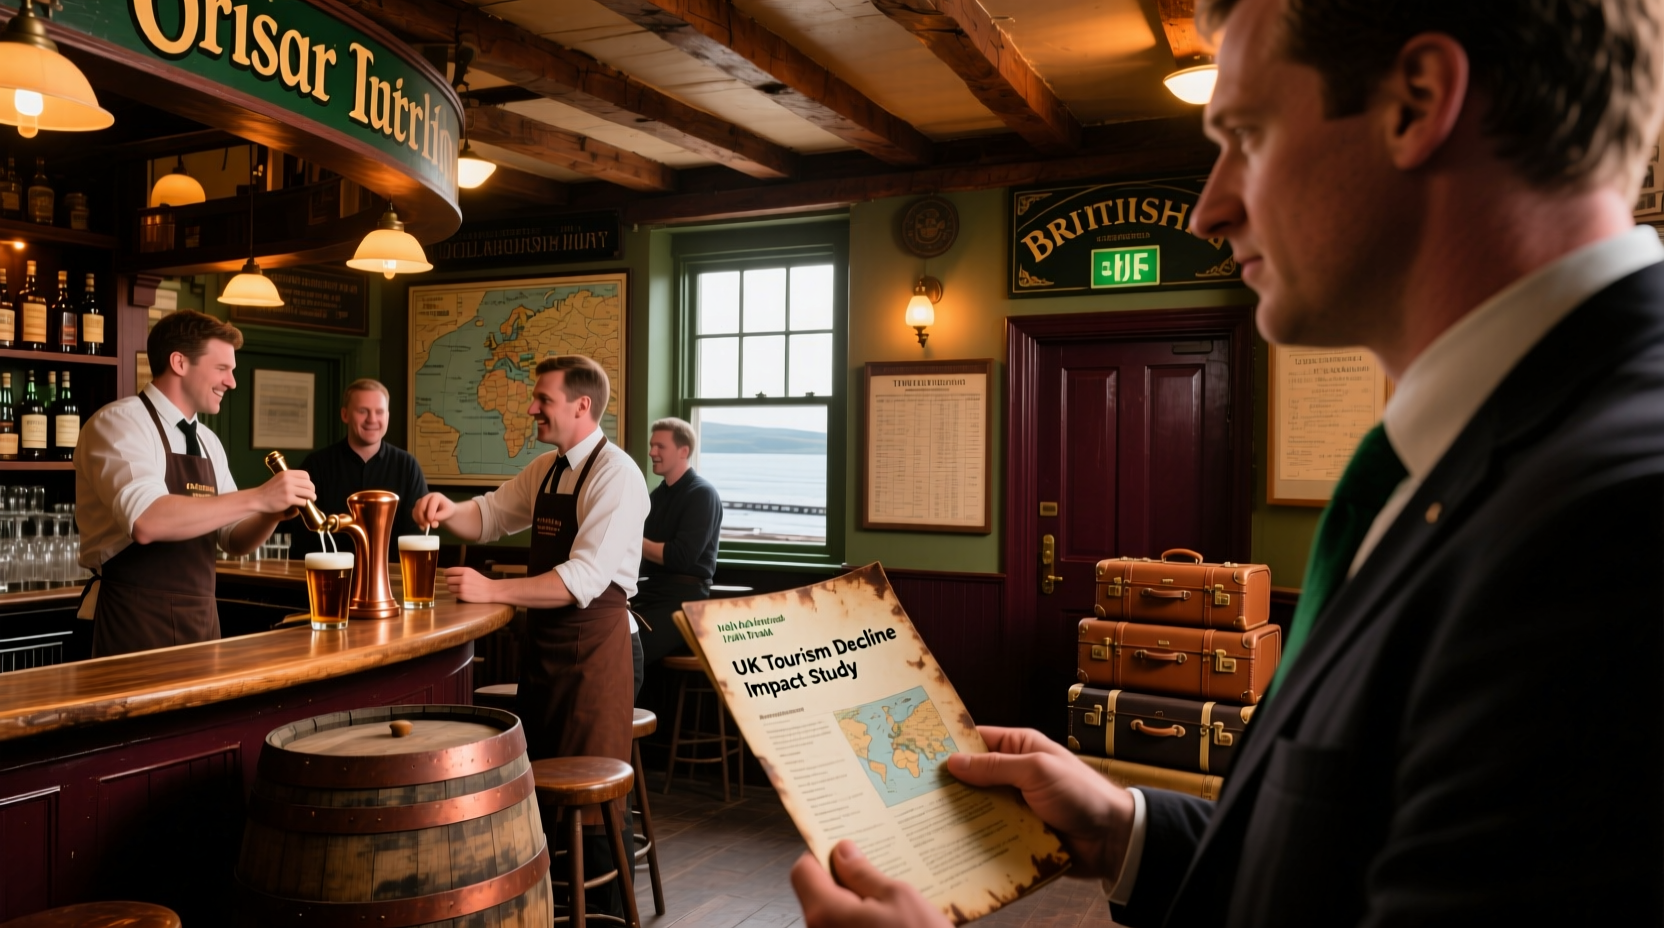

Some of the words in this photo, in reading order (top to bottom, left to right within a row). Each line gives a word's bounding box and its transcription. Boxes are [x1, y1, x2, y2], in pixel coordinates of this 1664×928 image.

[732, 656, 763, 676] UK
[761, 647, 832, 671] Tourism
[832, 627, 897, 655] Decline
[744, 672, 807, 698] Impact
[808, 660, 858, 684] Study
